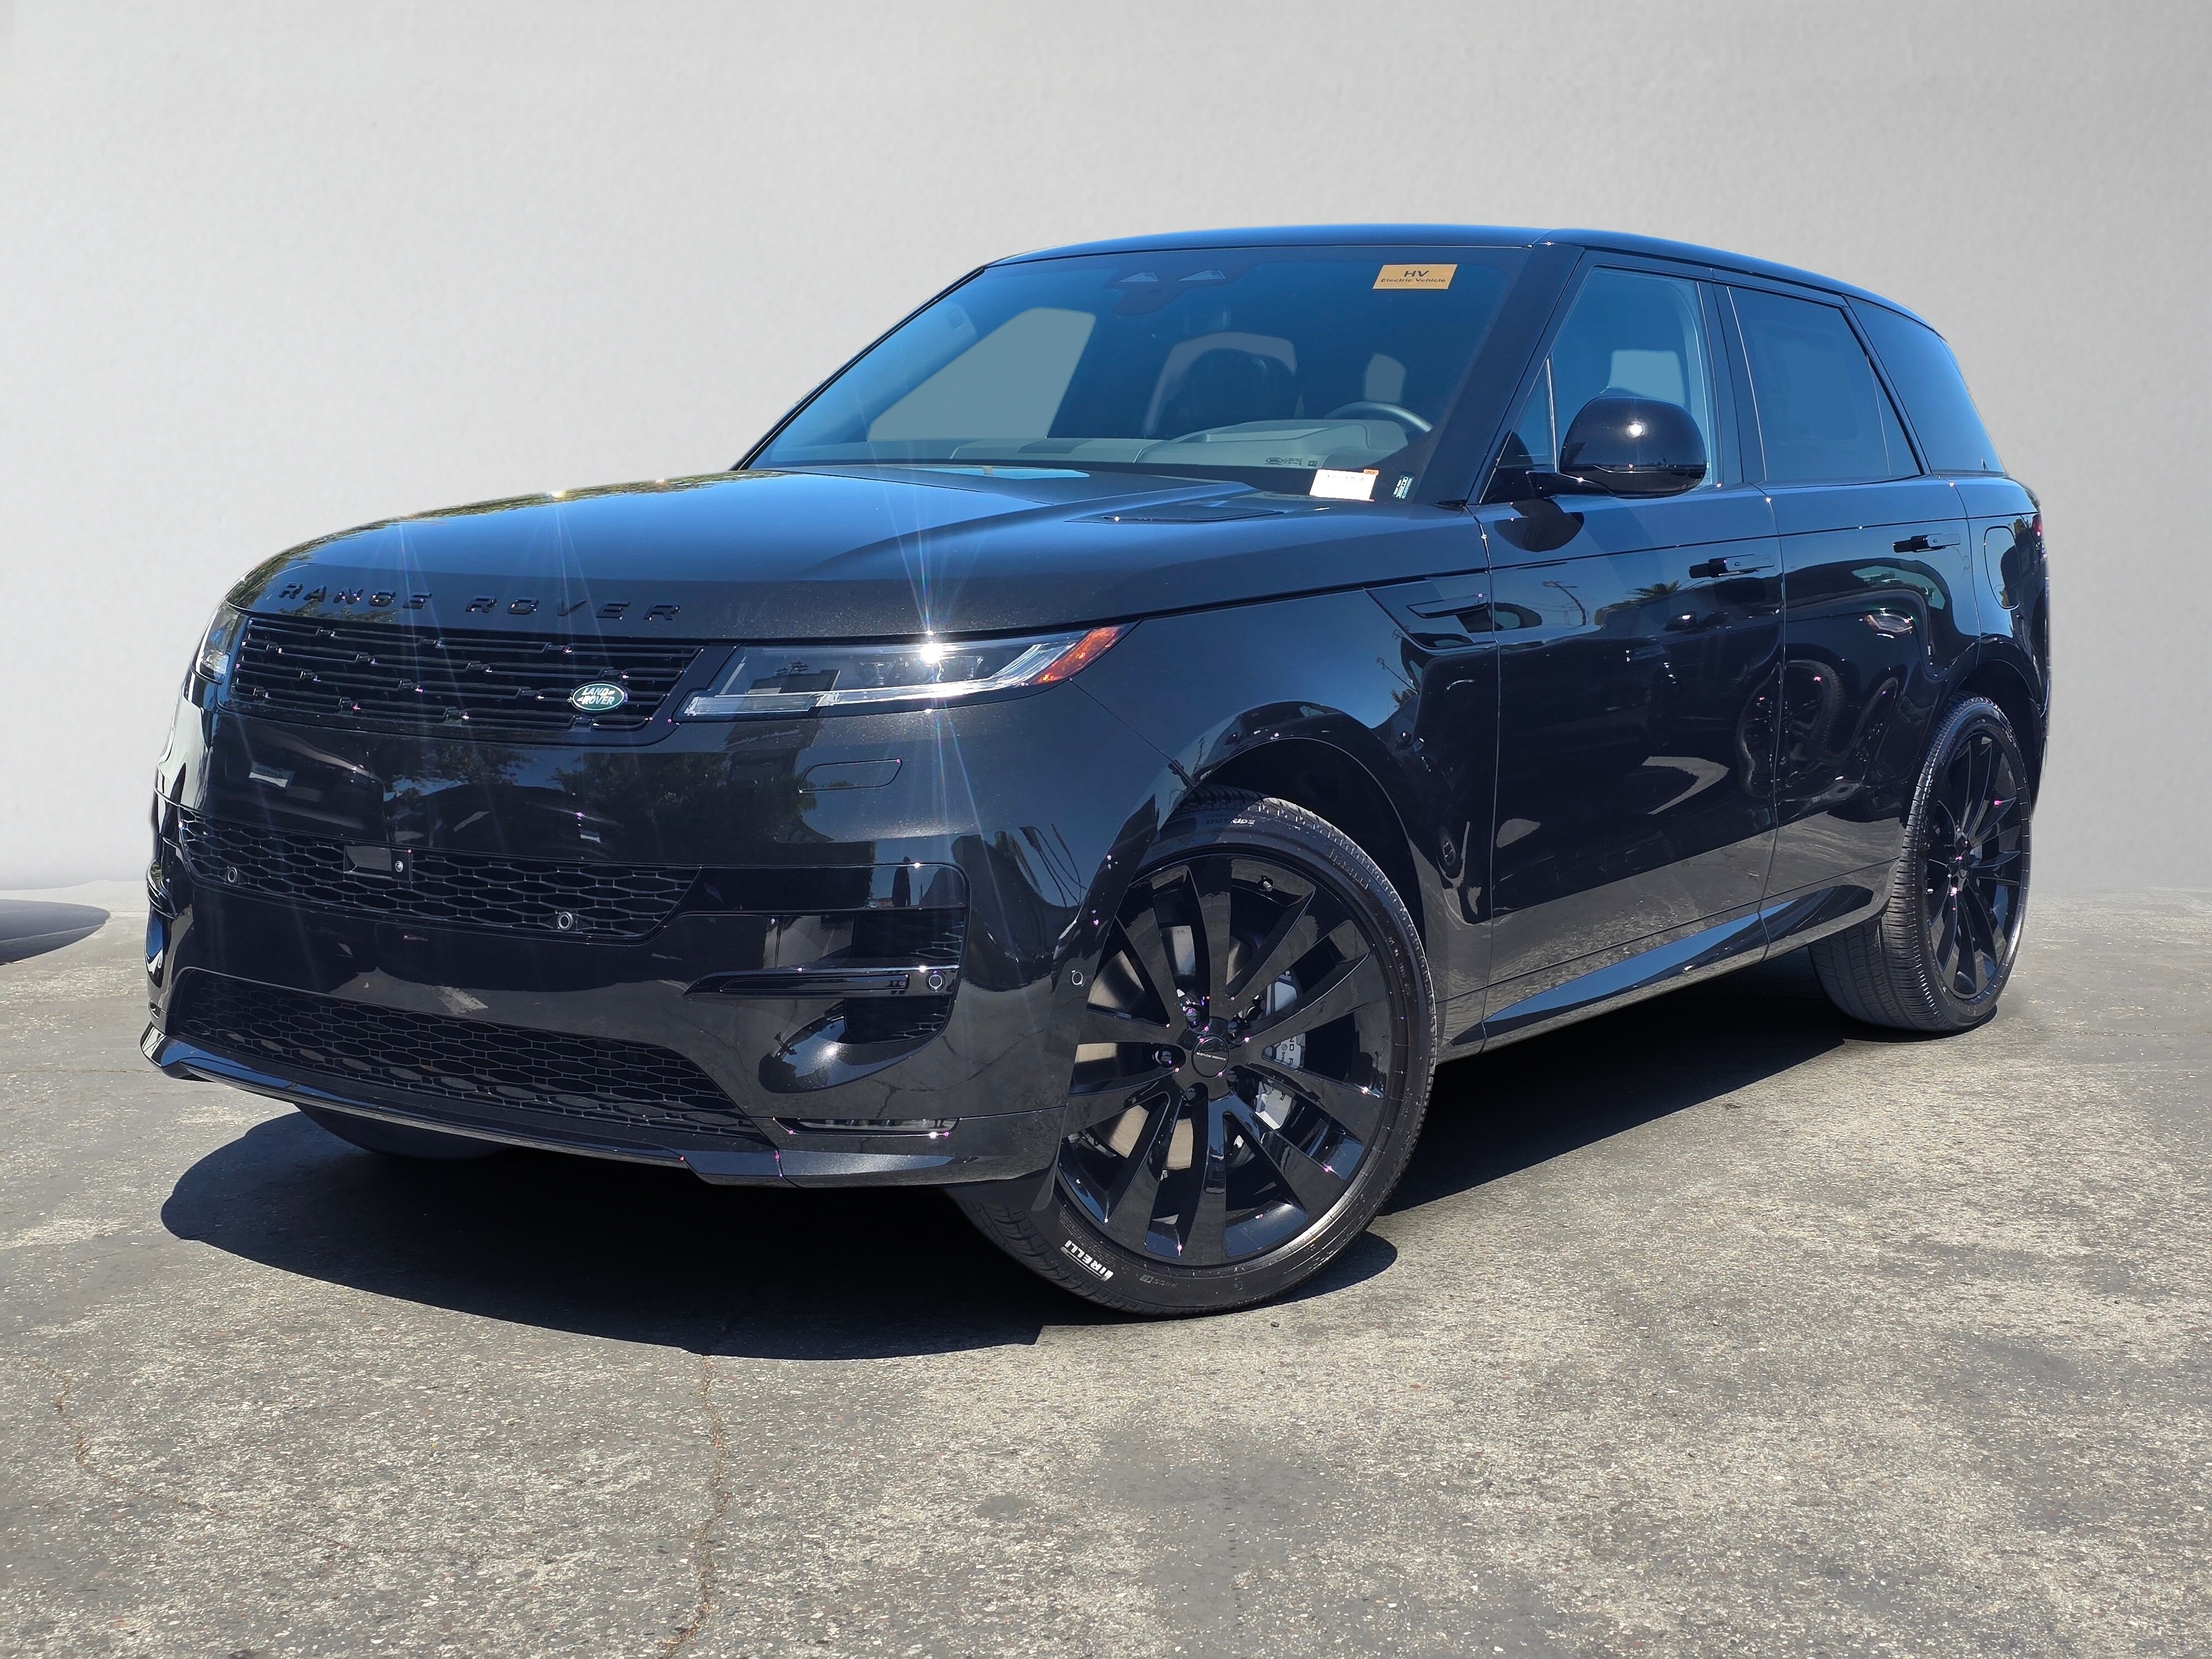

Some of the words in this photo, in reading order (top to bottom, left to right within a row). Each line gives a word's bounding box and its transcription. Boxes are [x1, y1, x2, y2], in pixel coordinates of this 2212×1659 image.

[278, 582, 432, 609] RANGE
[465, 595, 681, 621] ROVER
[581, 696, 615, 705] ROVER
[582, 687, 609, 696] LAND
[1064, 1240, 1114, 1282] PIRELLI
